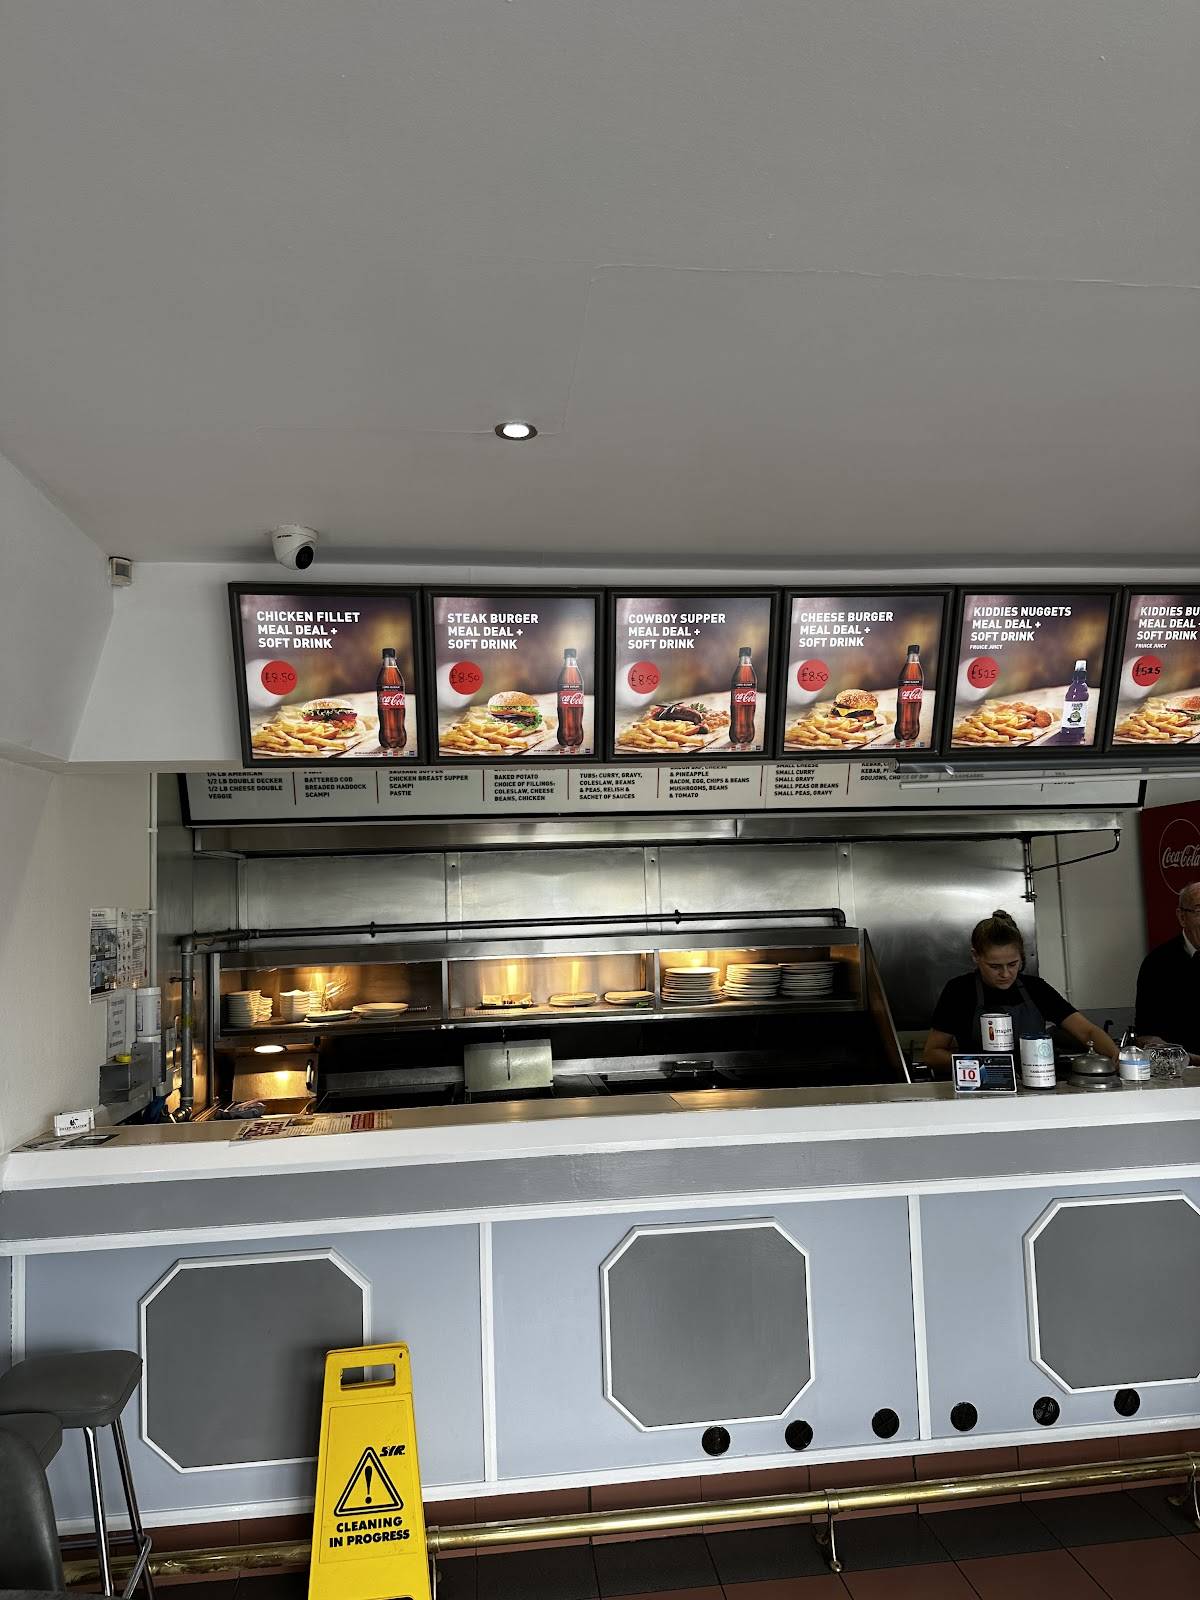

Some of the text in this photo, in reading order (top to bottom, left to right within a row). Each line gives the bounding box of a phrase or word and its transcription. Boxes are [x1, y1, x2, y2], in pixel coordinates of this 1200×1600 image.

[257, 611, 360, 623] CHICKEN FILLET
[800, 611, 893, 623] CHEESE BURGER
[973, 606, 1072, 617] KIDDIES NUGGETS
[1140, 606, 1183, 617] KIDDIES
[447, 613, 539, 624] STEAK BURGER
[628, 613, 726, 624] COWBOY SUPPER
[1138, 618, 1196, 629] MEAL DEAL
[257, 624, 292, 635] MEAL
[295, 625, 328, 636] DEAL
[972, 619, 1002, 630] MEAL
[1005, 619, 1032, 629] DEAL
[448, 626, 482, 637] MEAL
[484, 626, 514, 637] DEAL
[628, 626, 659, 637] MEAL
[662, 626, 692, 636] DEAL
[800, 625, 831, 636] MEAL
[833, 625, 862, 635] DEAL
[1136, 630, 1198, 641] SOFT DRINK
[970, 631, 1035, 642] SOFT DRINK
[258, 637, 332, 649] SOFT DRINK
[448, 639, 517, 649] SOFT DRINK
[628, 638, 695, 650] SOFT DRINK
[799, 637, 865, 648] SOFT DRINK
[336, 1517, 402, 1532] CLEANING
[329, 1529, 410, 1548] IN PROGRESS
